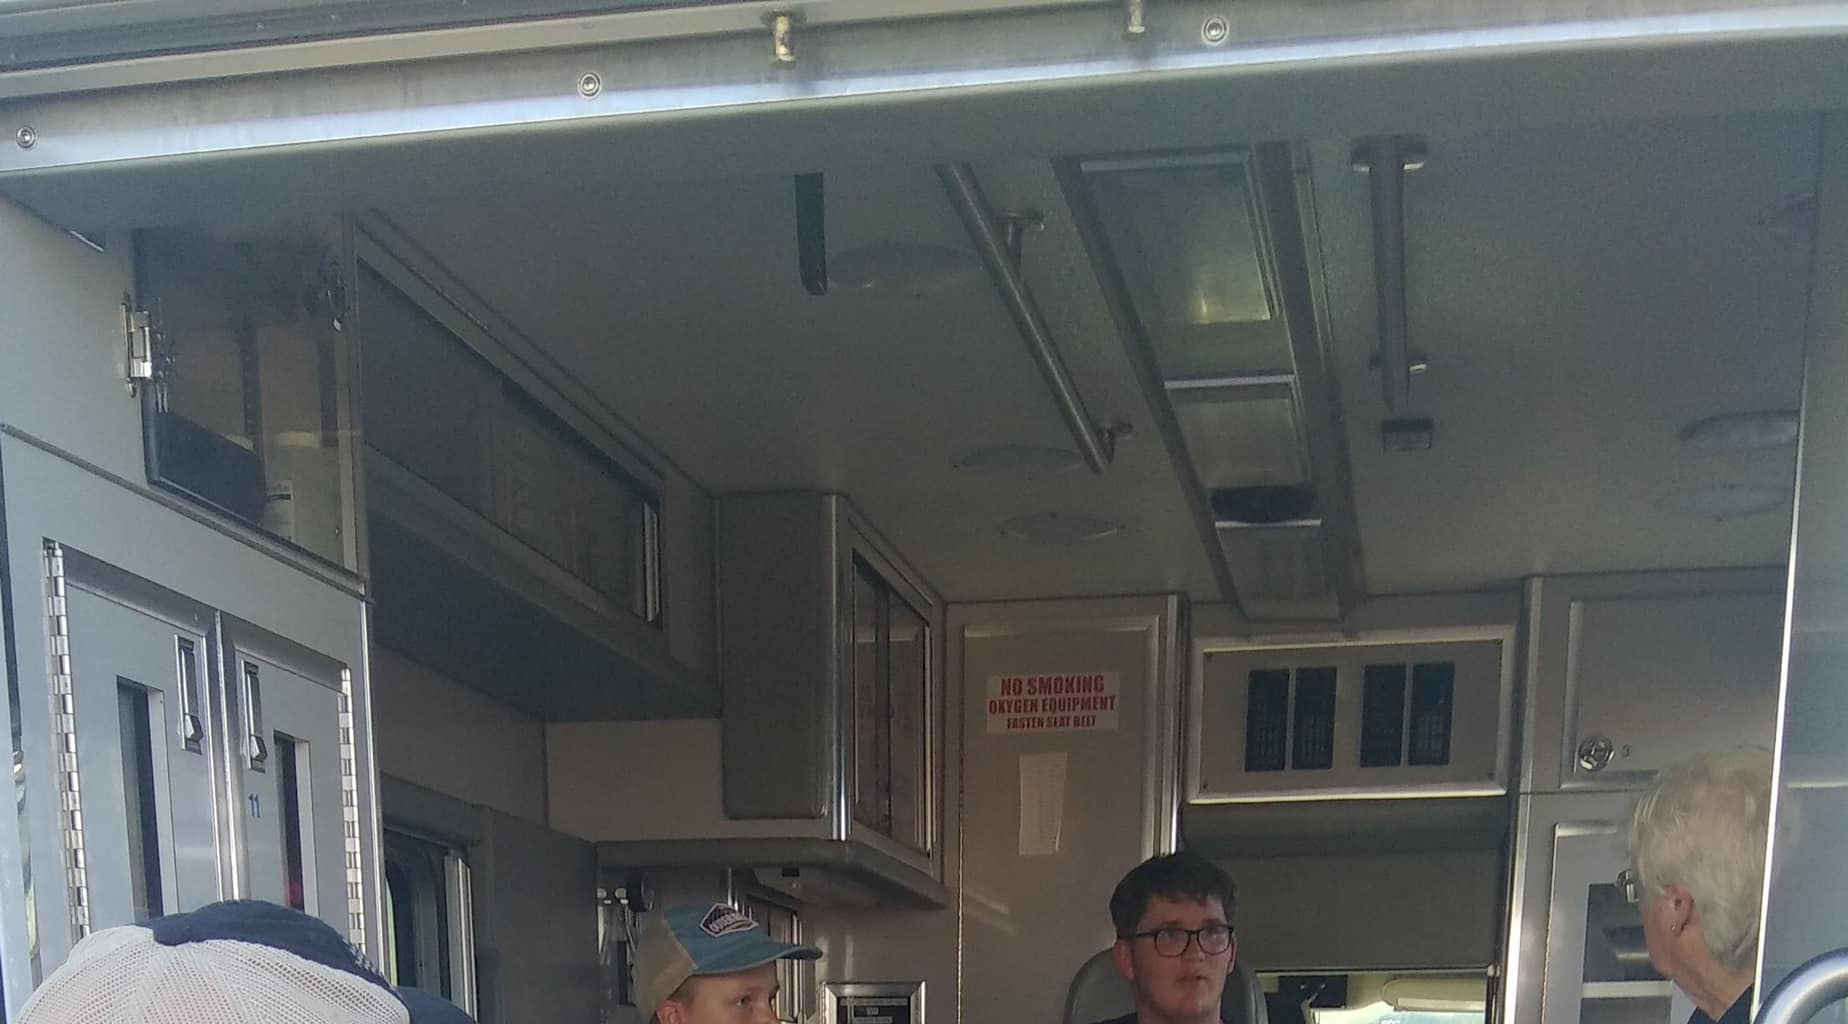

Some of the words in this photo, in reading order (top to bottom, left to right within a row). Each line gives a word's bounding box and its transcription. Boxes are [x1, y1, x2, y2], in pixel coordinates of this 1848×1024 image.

[1001, 678, 1023, 696] NO
[1027, 675, 1105, 696] SMOKING
[989, 699, 1038, 715] OXYGEN
[1042, 696, 1116, 714] EQUIPMENT
[1007, 717, 1044, 729] FASTEN
[1047, 716, 1071, 728] SEAT
[1074, 715, 1096, 727] BELT
